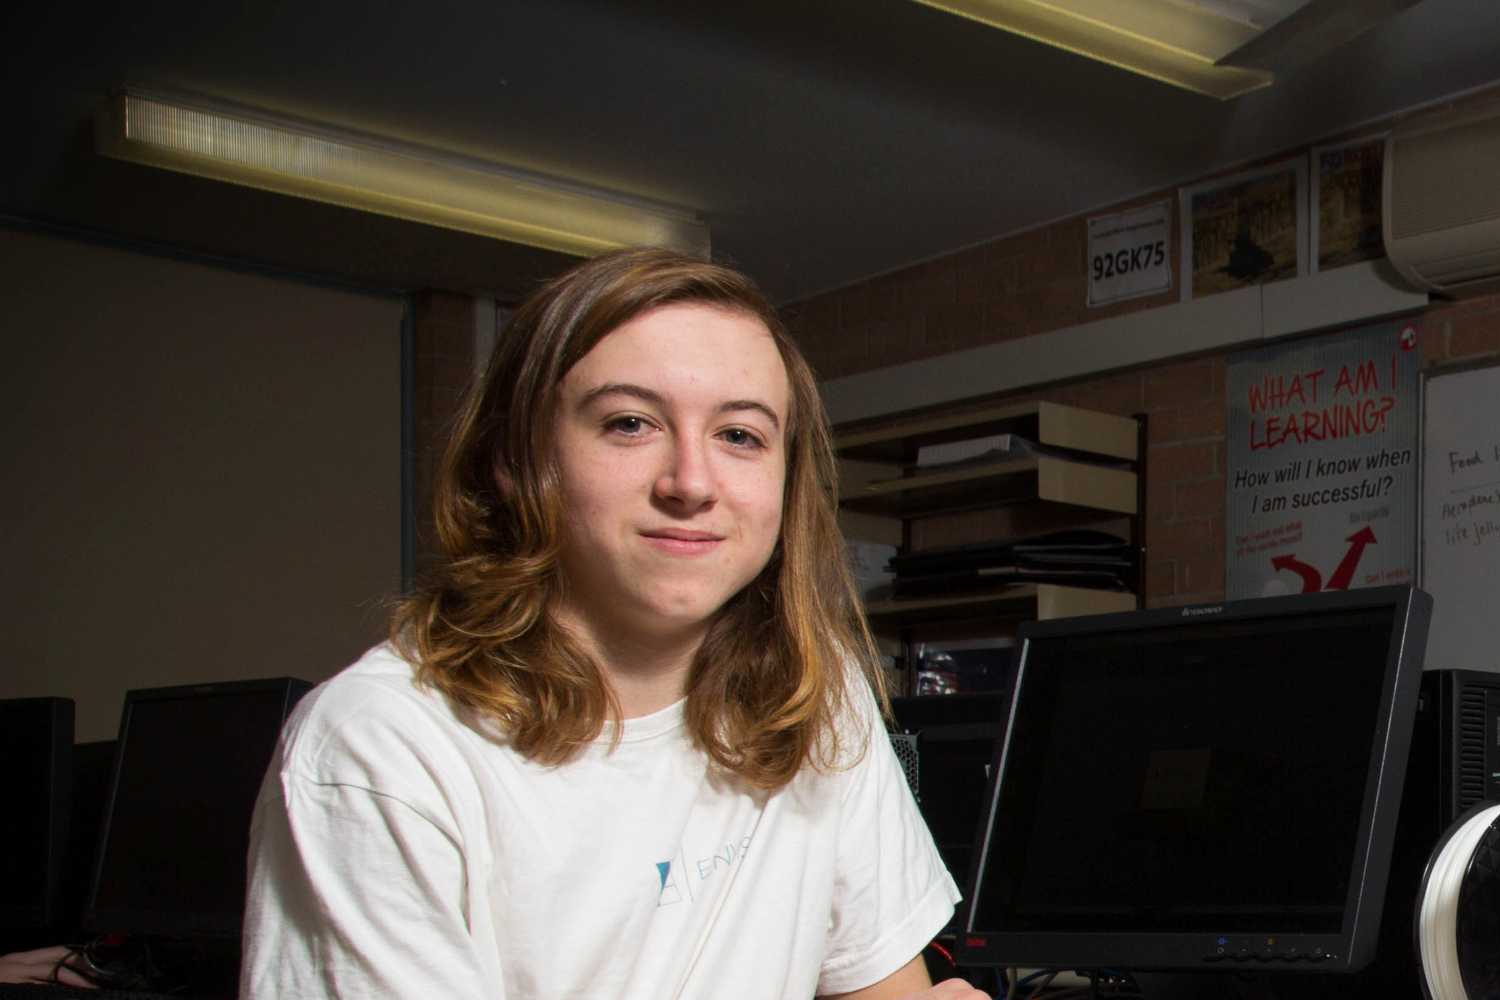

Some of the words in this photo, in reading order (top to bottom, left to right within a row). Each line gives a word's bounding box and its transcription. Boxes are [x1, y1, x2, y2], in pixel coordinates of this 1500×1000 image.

[1093, 242, 1164, 280] 92GK75
[1250, 369, 1325, 414] WHAT
[1334, 358, 1379, 398] AM
[1391, 353, 1397, 389] I
[1250, 396, 1396, 450] LEARNING?
[1235, 467, 1270, 489] How
[1274, 460, 1302, 484] will
[1305, 461, 1311, 478] I
[1316, 454, 1362, 478] know
[1366, 448, 1411, 471] when
[1252, 495, 1257, 513] I
[1262, 495, 1289, 513] am
[1292, 475, 1394, 509] successful?
